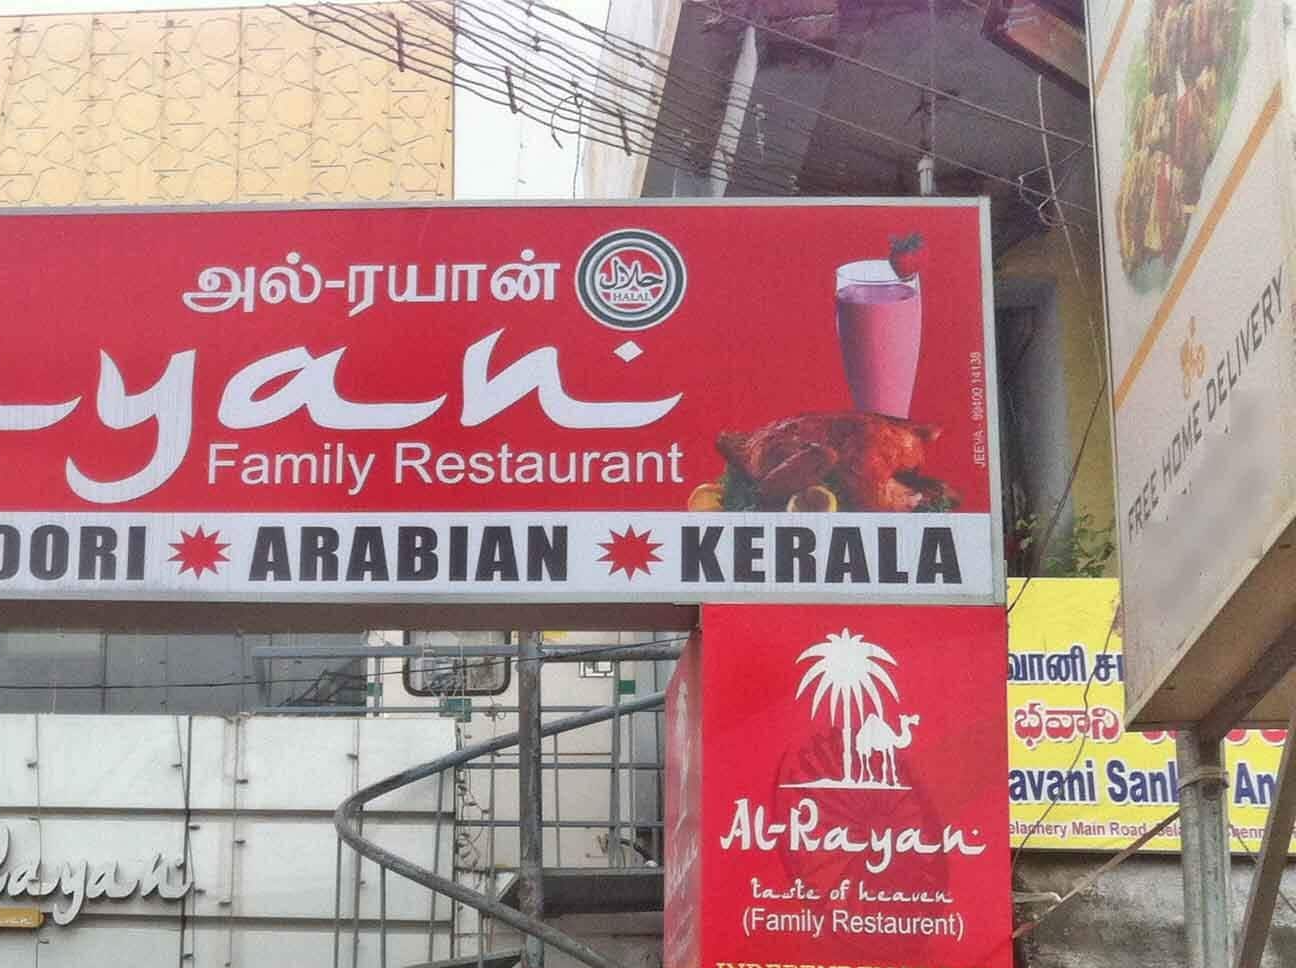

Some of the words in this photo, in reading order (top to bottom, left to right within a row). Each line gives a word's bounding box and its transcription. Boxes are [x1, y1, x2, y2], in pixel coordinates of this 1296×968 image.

[182, 249, 560, 318] அல்-ரயான்
[1128, 468, 1159, 543] FREE
[1161, 400, 1202, 492] HOME
[1205, 264, 1285, 422] DELIVERY
[208, 442, 375, 495] Family
[394, 441, 684, 485] Restaurant
[973, 429, 987, 468] JEEVA
[248, 525, 568, 582] ARABIAN
[680, 525, 963, 585] KERALA
[1072, 821, 1105, 836] Main
[751, 877, 821, 901] taste
[830, 879, 852, 902] of
[859, 882, 953, 904] heaven
[742, 907, 825, 938] (Family
[832, 910, 965, 941] Restaurent)
